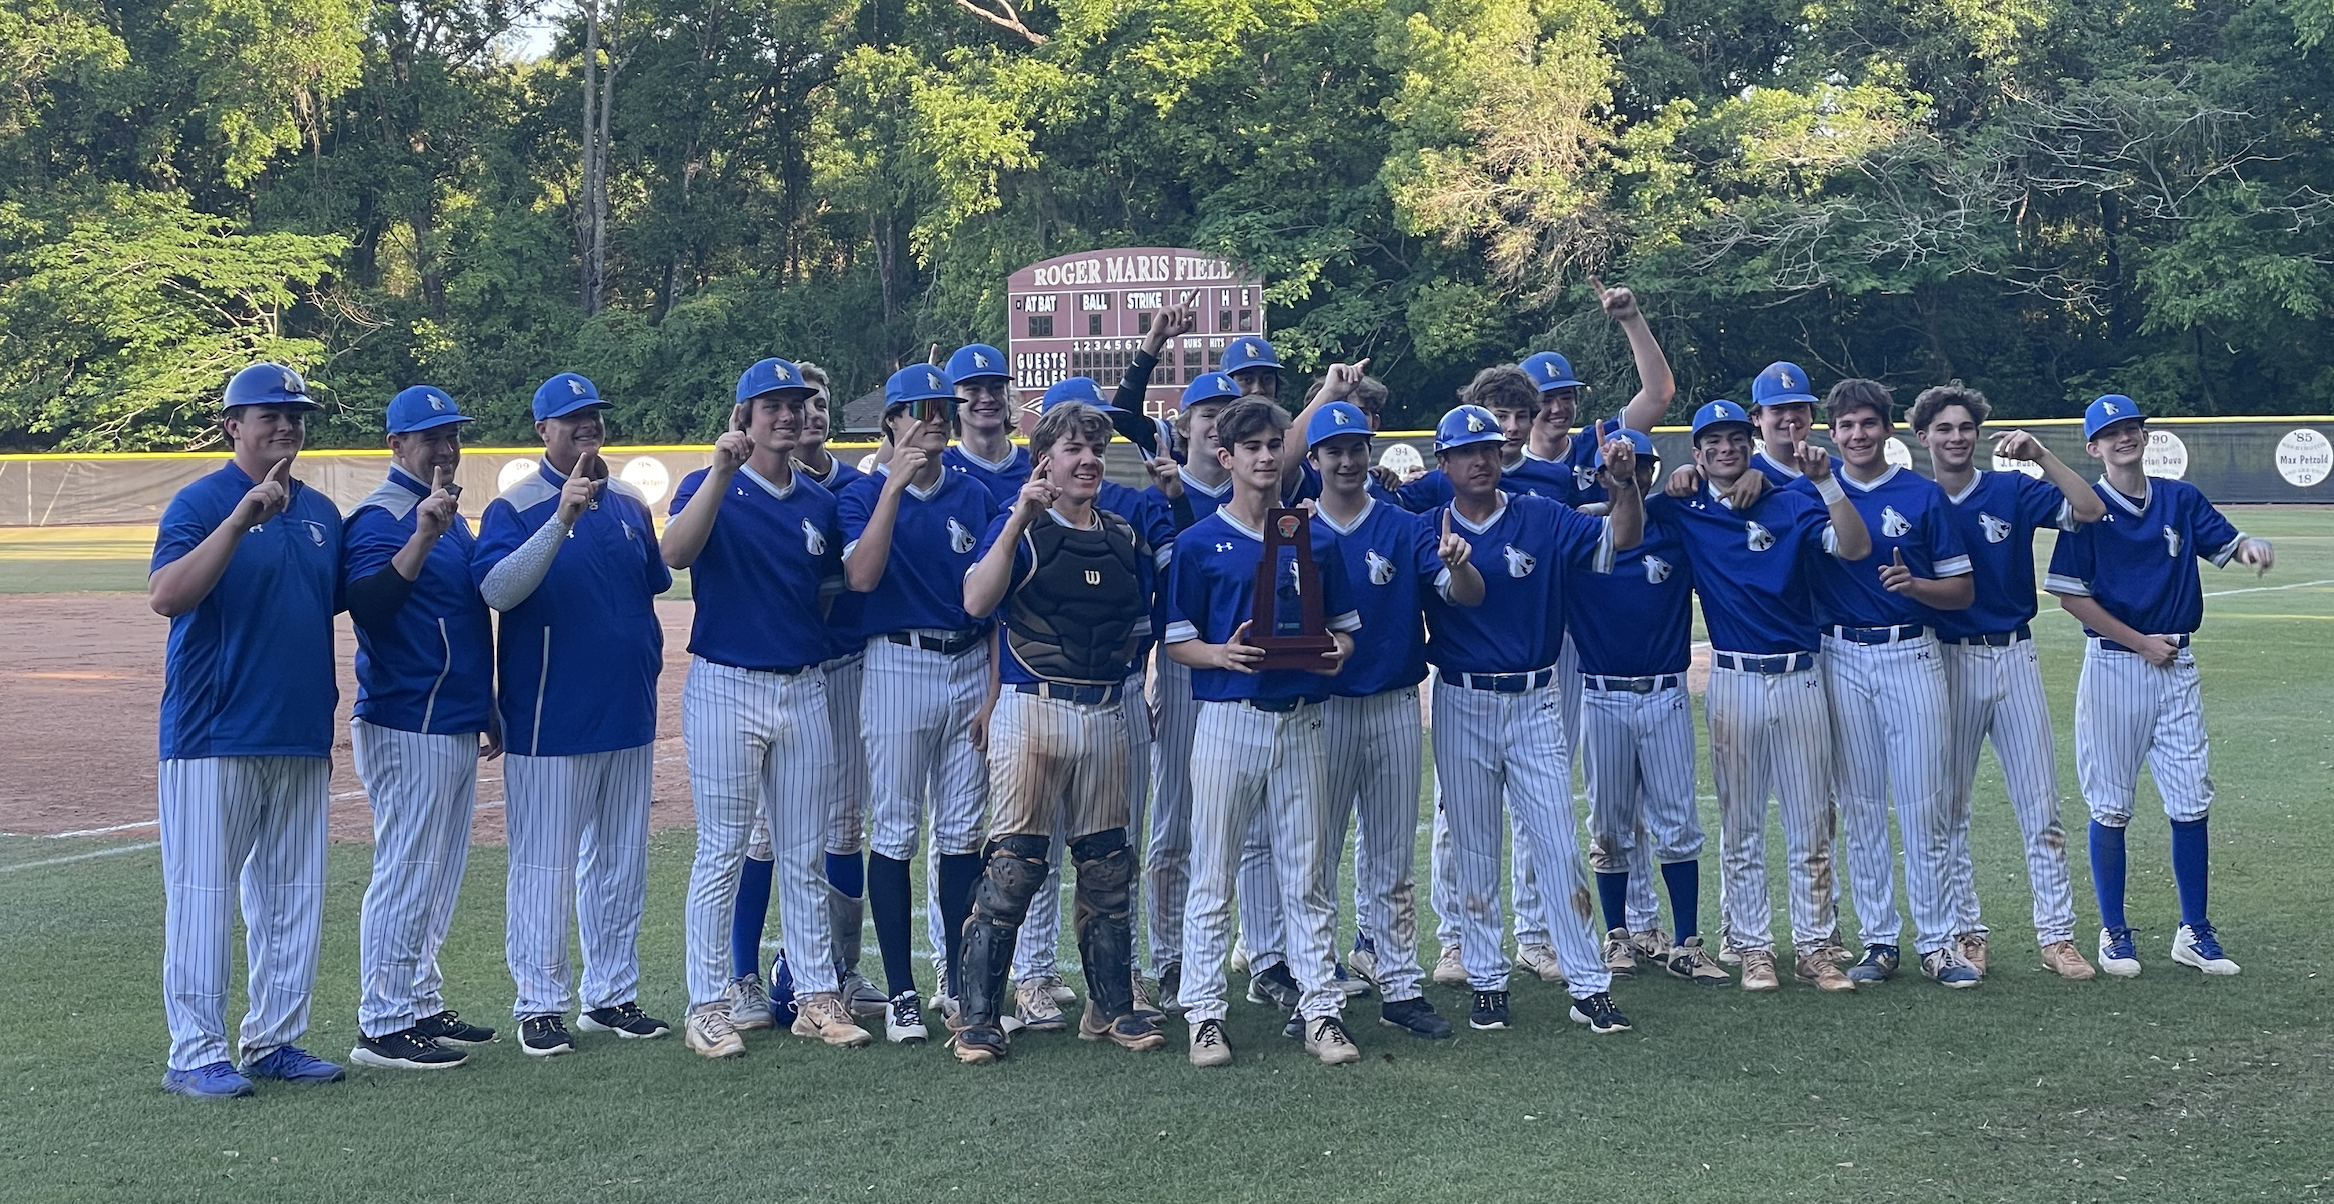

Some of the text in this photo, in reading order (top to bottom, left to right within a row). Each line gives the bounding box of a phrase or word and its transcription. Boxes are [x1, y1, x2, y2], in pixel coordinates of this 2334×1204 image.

[1034, 258, 1102, 286] ROGER
[1106, 255, 1170, 283] MARIS
[1024, 295, 1057, 312] AT BAT
[1082, 293, 1107, 310] BALL
[1127, 292, 1162, 309] STRIKE
[1221, 289, 1230, 307] H
[1241, 289, 1249, 306] E
[1073, 341, 1080, 351] 1
[1083, 340, 1091, 351] 2
[1094, 340, 1101, 351] 3
[1104, 340, 1111, 351] 4
[1114, 340, 1121, 350] 5
[1125, 339, 1132, 350] 6
[1135, 339, 1142, 350] 7
[1183, 338, 1202, 349] RUNS
[1209, 337, 1225, 348] HITS
[1017, 352, 1067, 369] GUESTS
[1017, 370, 1067, 387] EAGLES
[2144, 456, 2160, 466] rian
[2280, 454, 2329, 465] Max Petzold
[2298, 474, 2312, 484] 18
